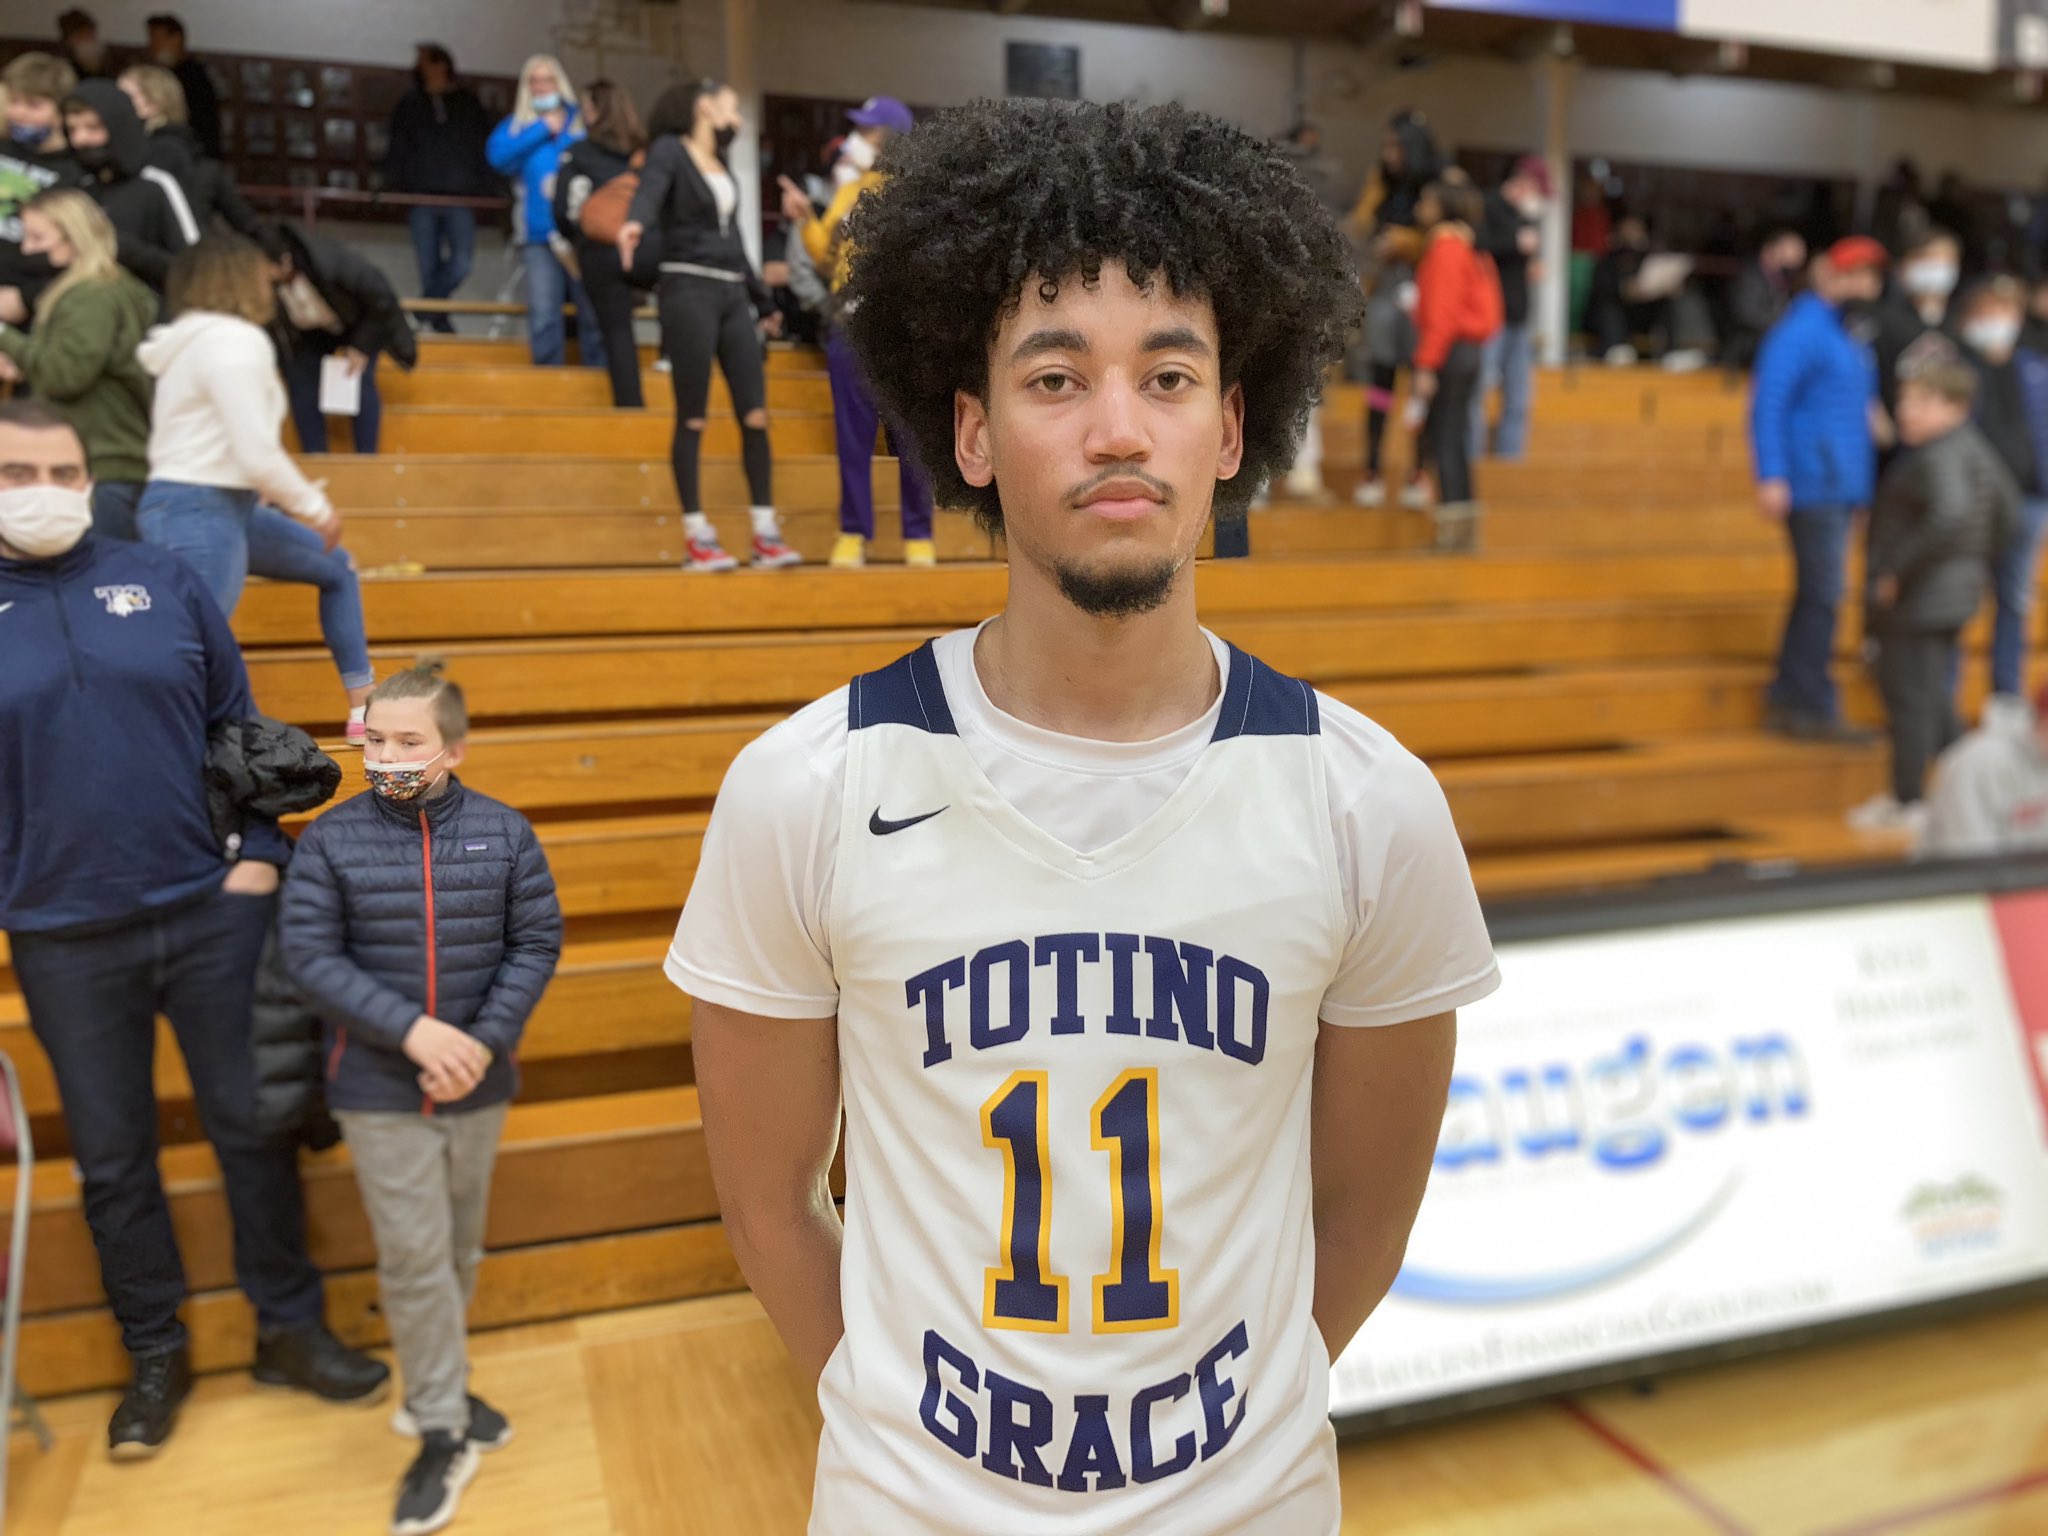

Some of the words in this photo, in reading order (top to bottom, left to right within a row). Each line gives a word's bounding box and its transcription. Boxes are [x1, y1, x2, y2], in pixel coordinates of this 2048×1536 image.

[905, 932, 1269, 1069] TOTINO
[1432, 1033, 1812, 1174] augen
[979, 1067, 1179, 1334] 11
[918, 1319, 1249, 1492] GRACE
